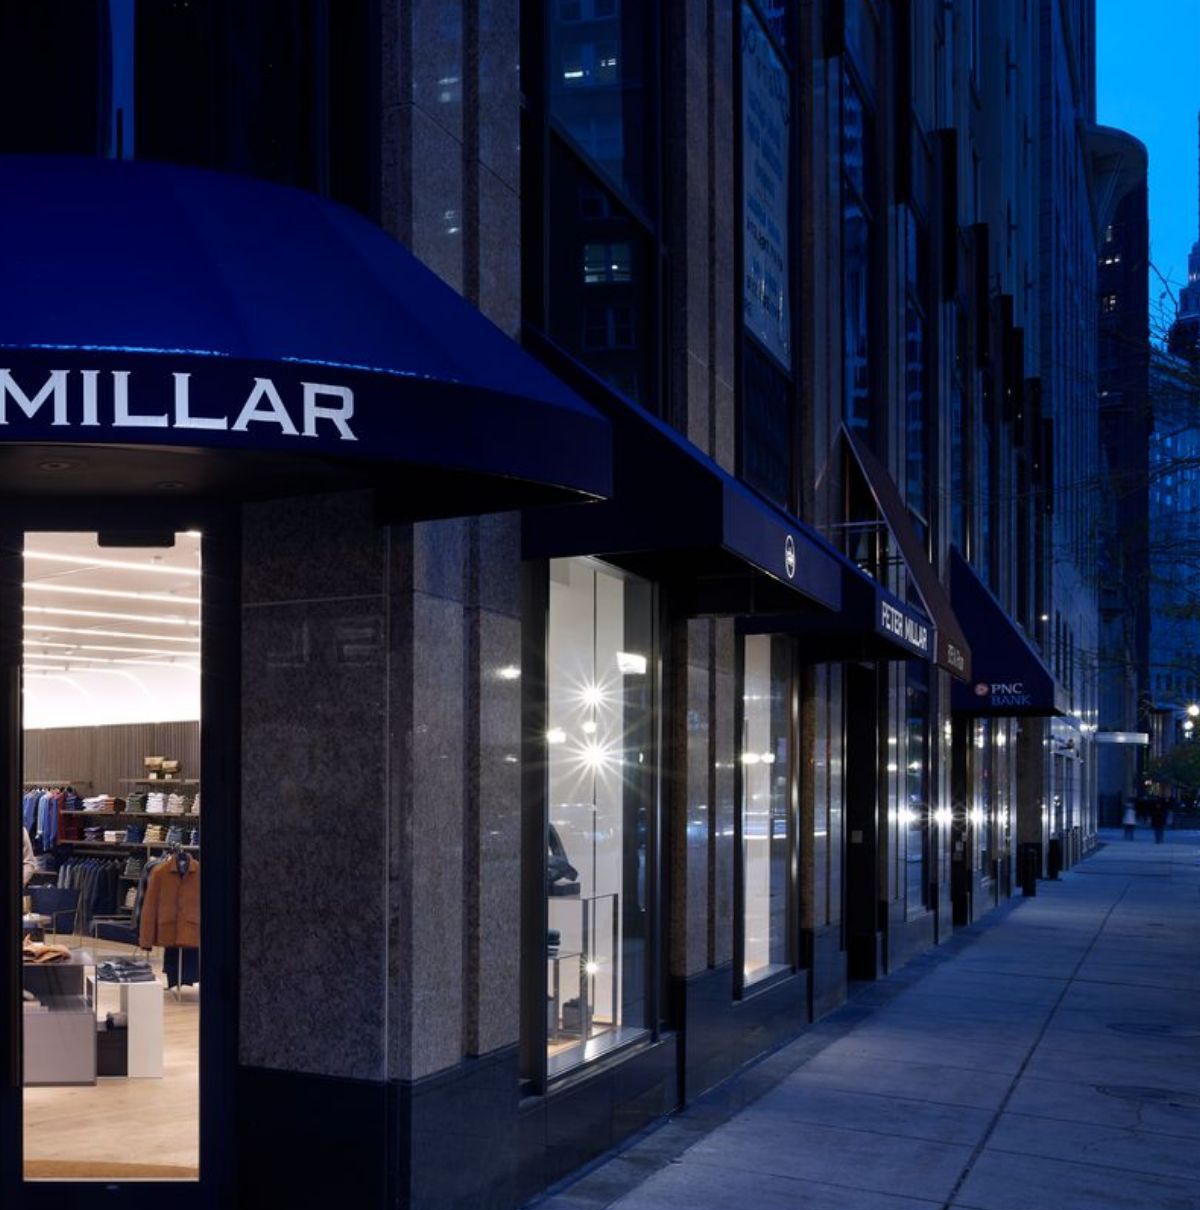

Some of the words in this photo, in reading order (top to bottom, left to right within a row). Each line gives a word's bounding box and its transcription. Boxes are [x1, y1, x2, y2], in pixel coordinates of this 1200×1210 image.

[881, 600, 904, 638] PETER
[904, 615, 928, 651] MILLAR
[991, 683, 1023, 695] PNC
[991, 694, 1031, 706] BANK
